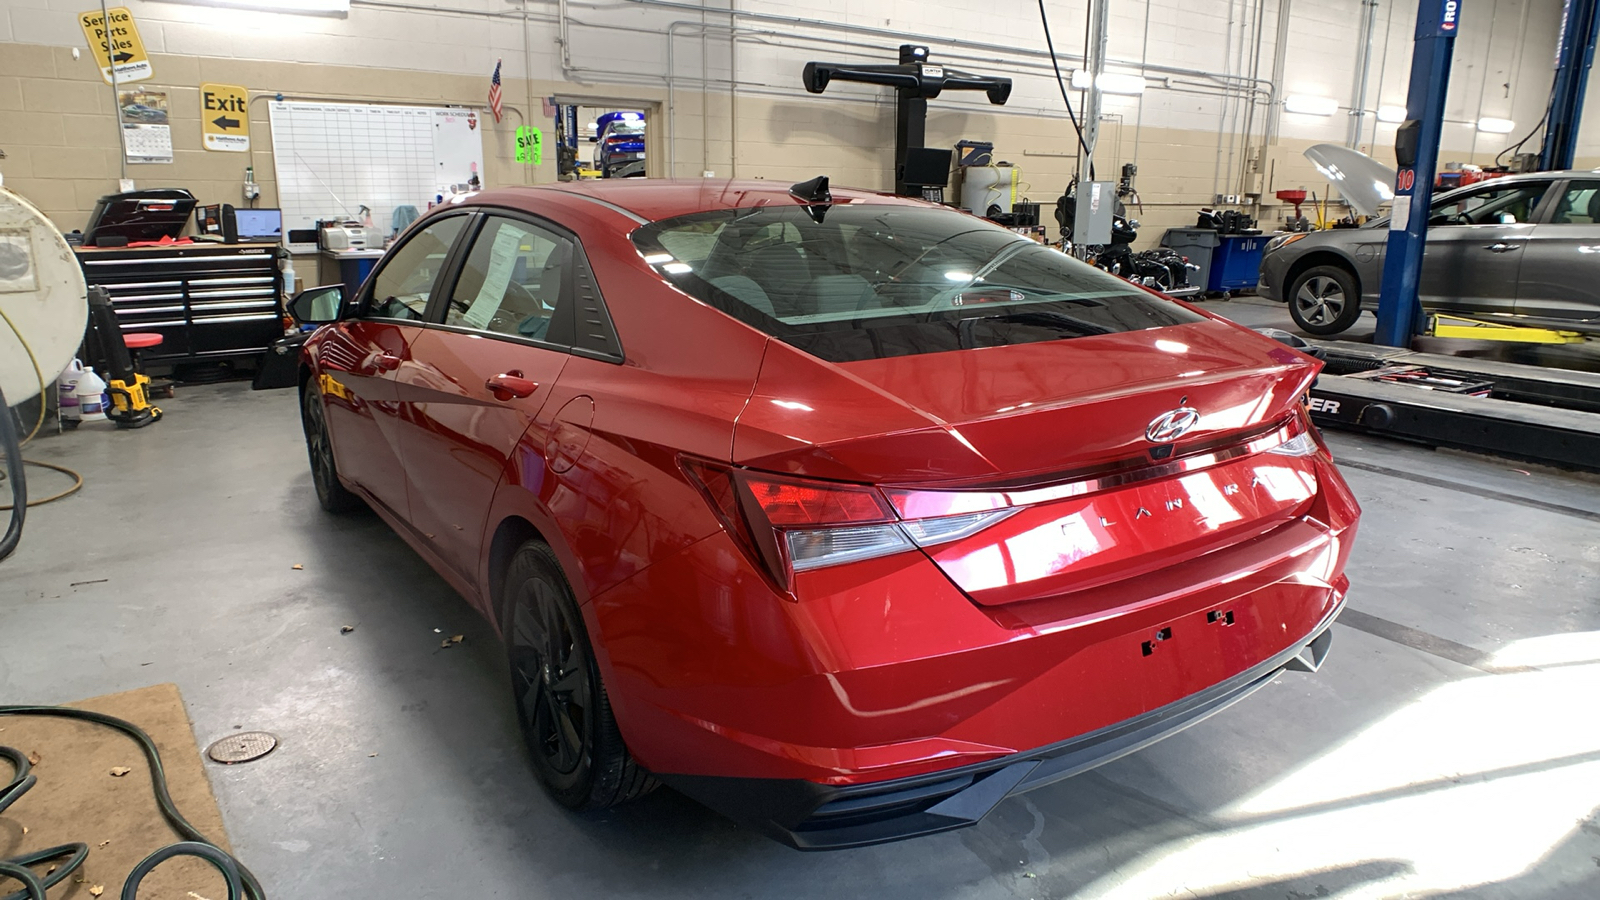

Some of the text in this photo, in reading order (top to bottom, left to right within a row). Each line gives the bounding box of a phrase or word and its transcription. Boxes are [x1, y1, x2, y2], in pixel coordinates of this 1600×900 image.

[83, 13, 128, 27] Serice
[204, 92, 245, 113] Exit
[1398, 169, 1414, 190] 10
[1061, 476, 1263, 536] ELANRA
